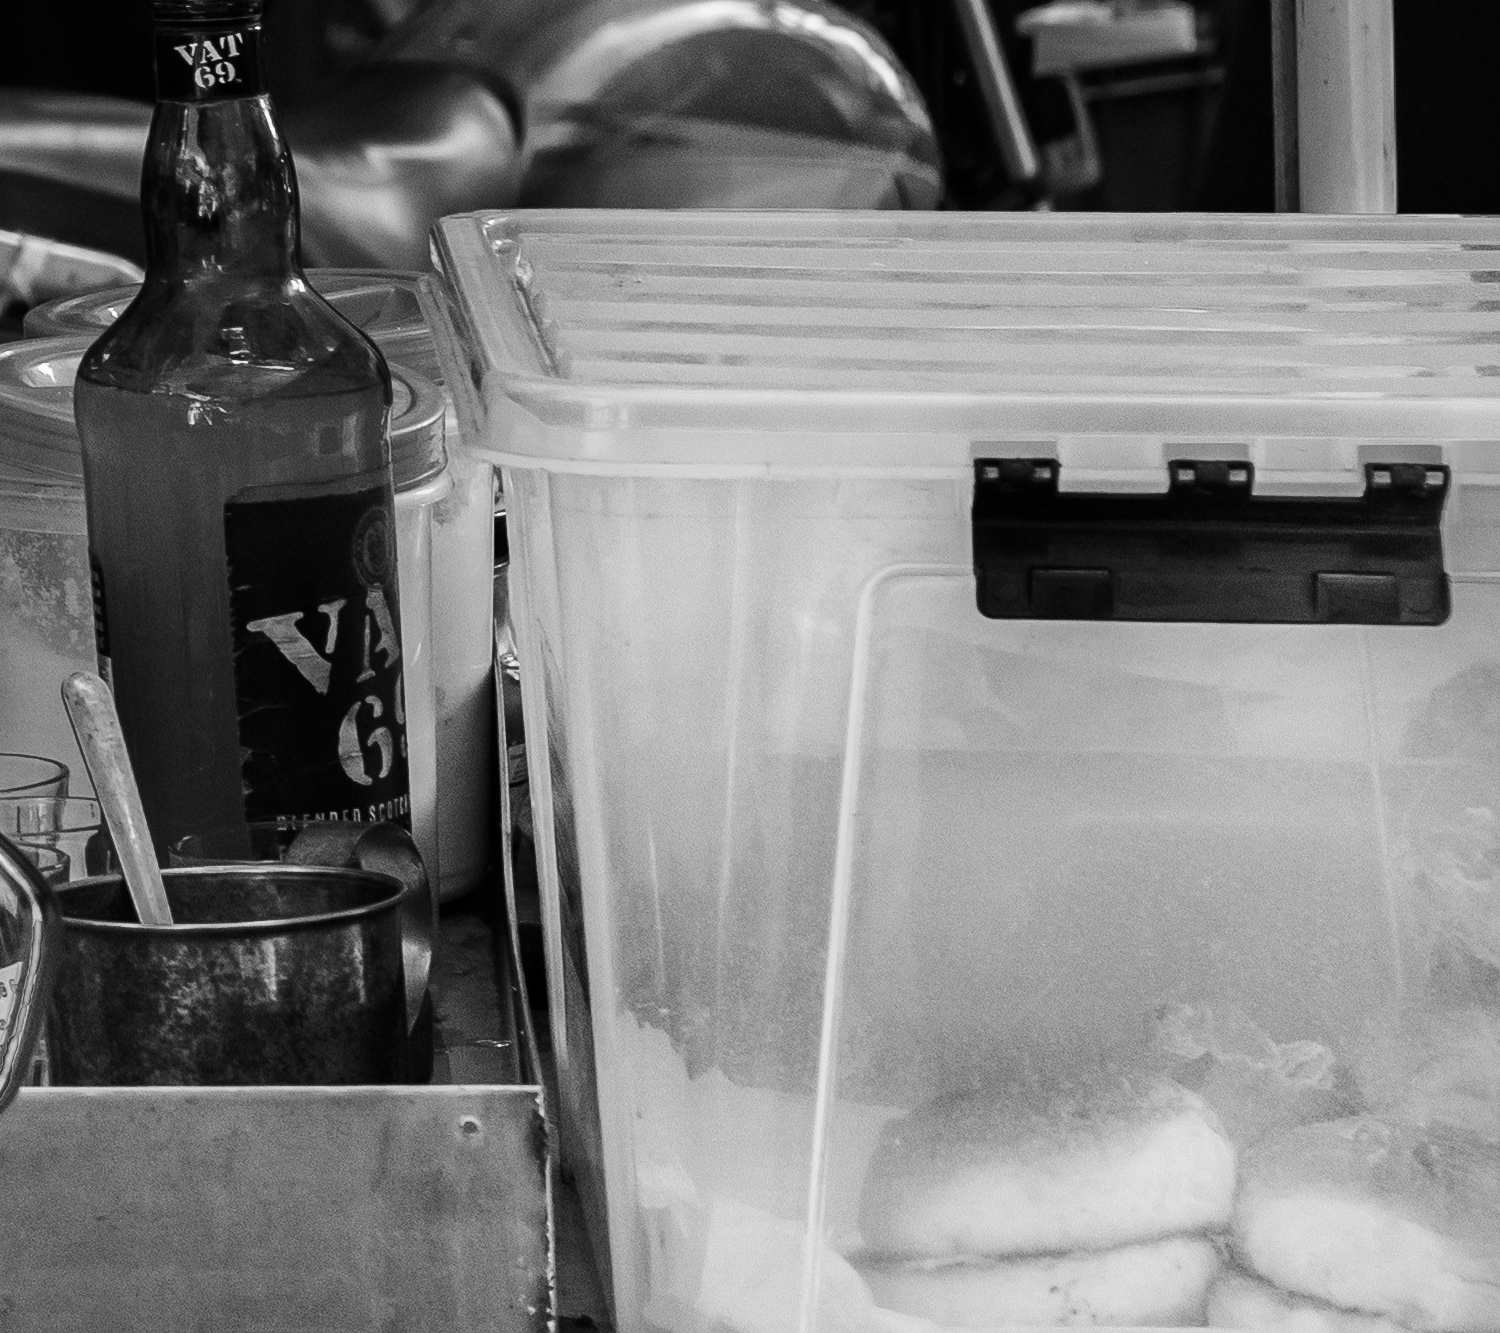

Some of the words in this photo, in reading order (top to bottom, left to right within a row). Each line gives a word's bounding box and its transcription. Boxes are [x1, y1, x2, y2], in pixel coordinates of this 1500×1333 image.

[173, 32, 244, 66] VAT
[194, 61, 237, 89] 69
[246, 587, 400, 697] VA
[338, 671, 407, 786] 6
